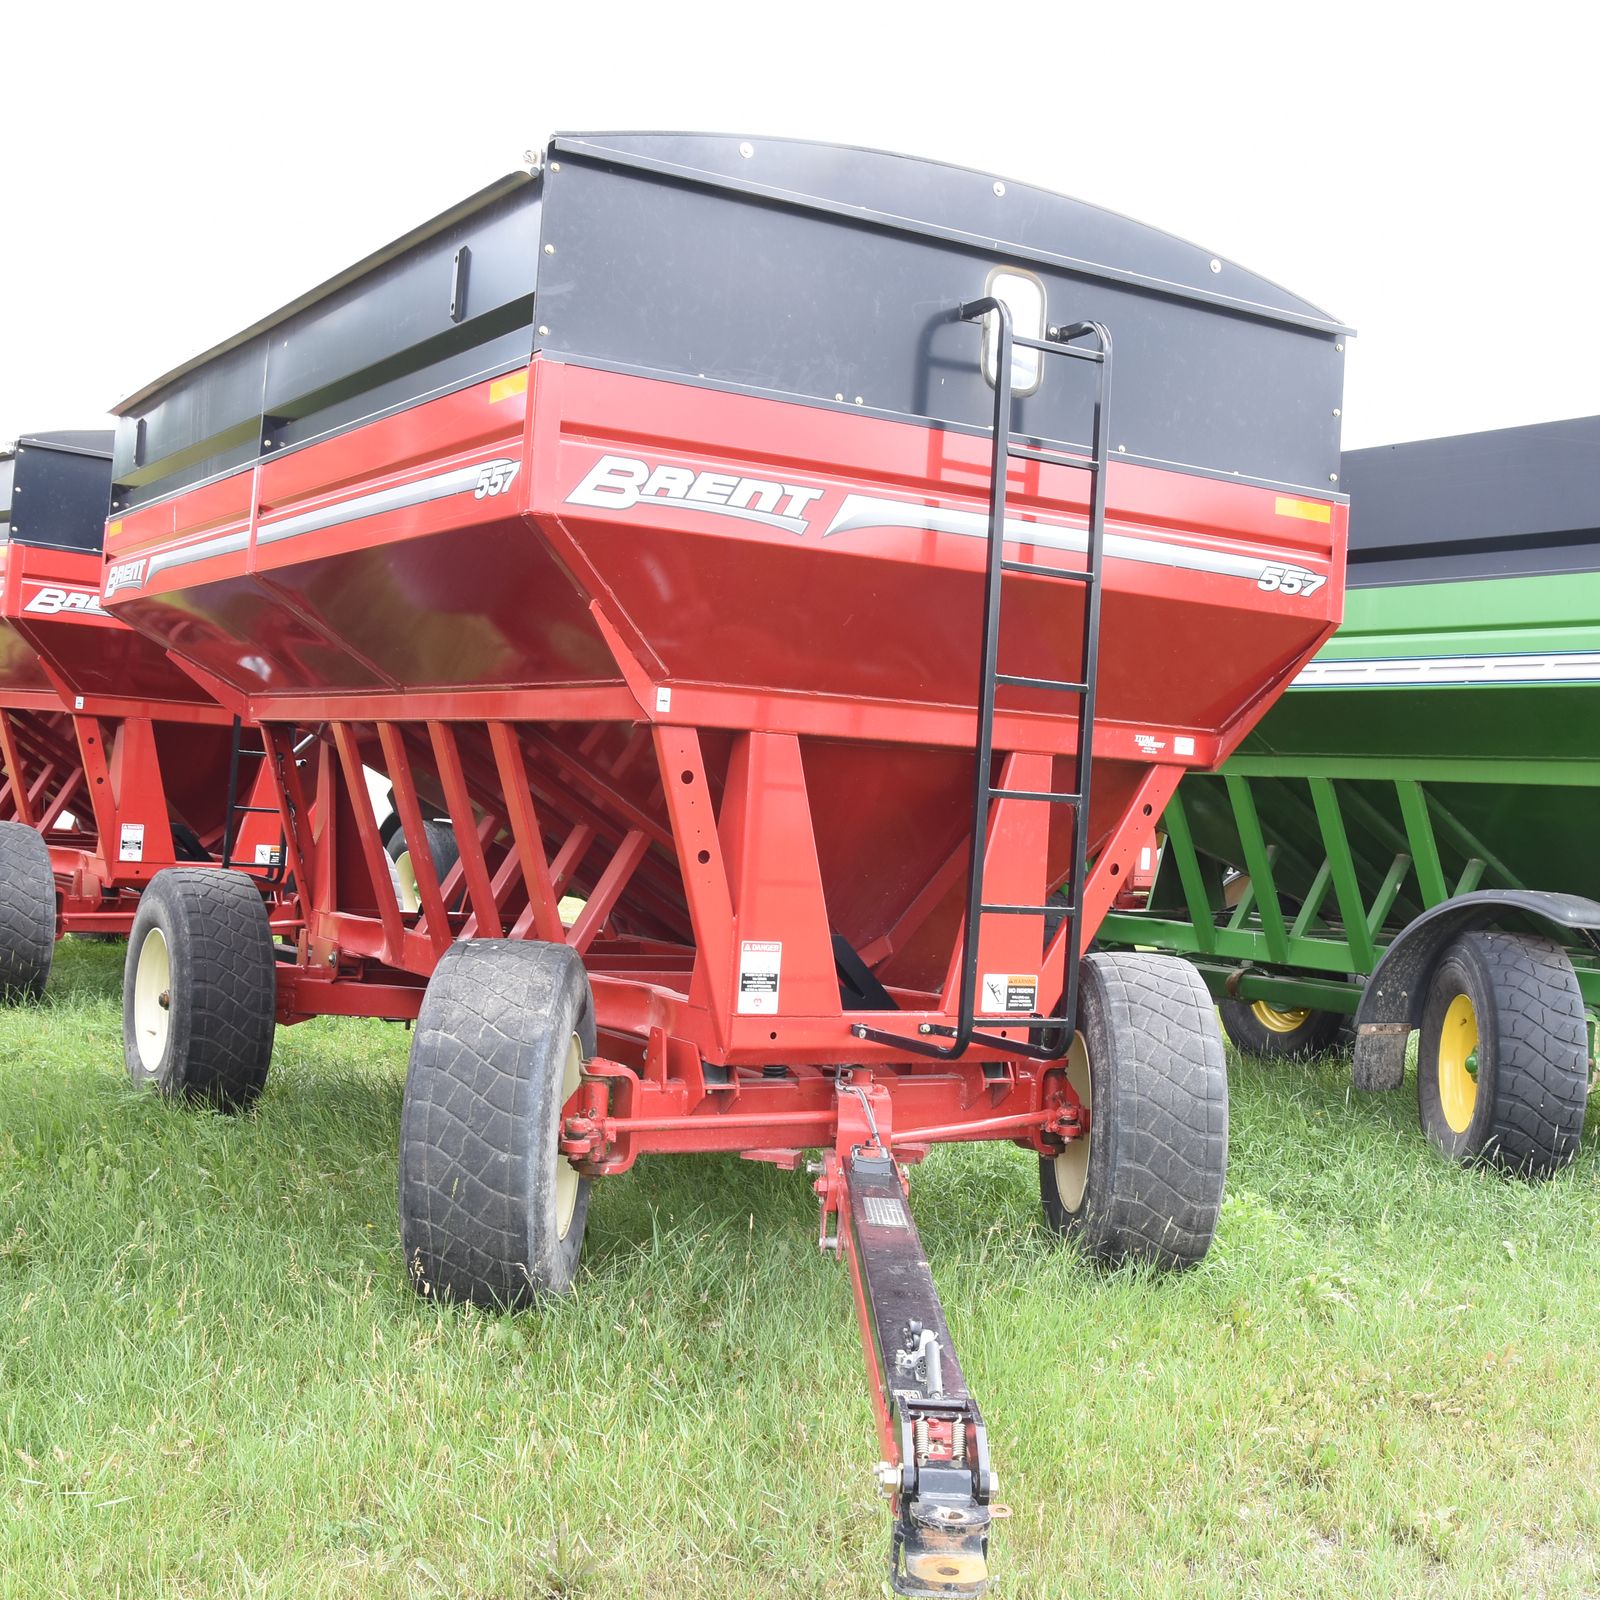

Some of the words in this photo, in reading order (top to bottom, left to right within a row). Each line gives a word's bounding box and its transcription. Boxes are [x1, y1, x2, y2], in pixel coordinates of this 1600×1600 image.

[474, 460, 521, 500] 557
[563, 454, 825, 522] BRENT
[104, 559, 147, 598] BRENT
[1257, 566, 1328, 597] 557
[24, 587, 102, 614] BRE
[751, 943, 779, 952] DANGER
